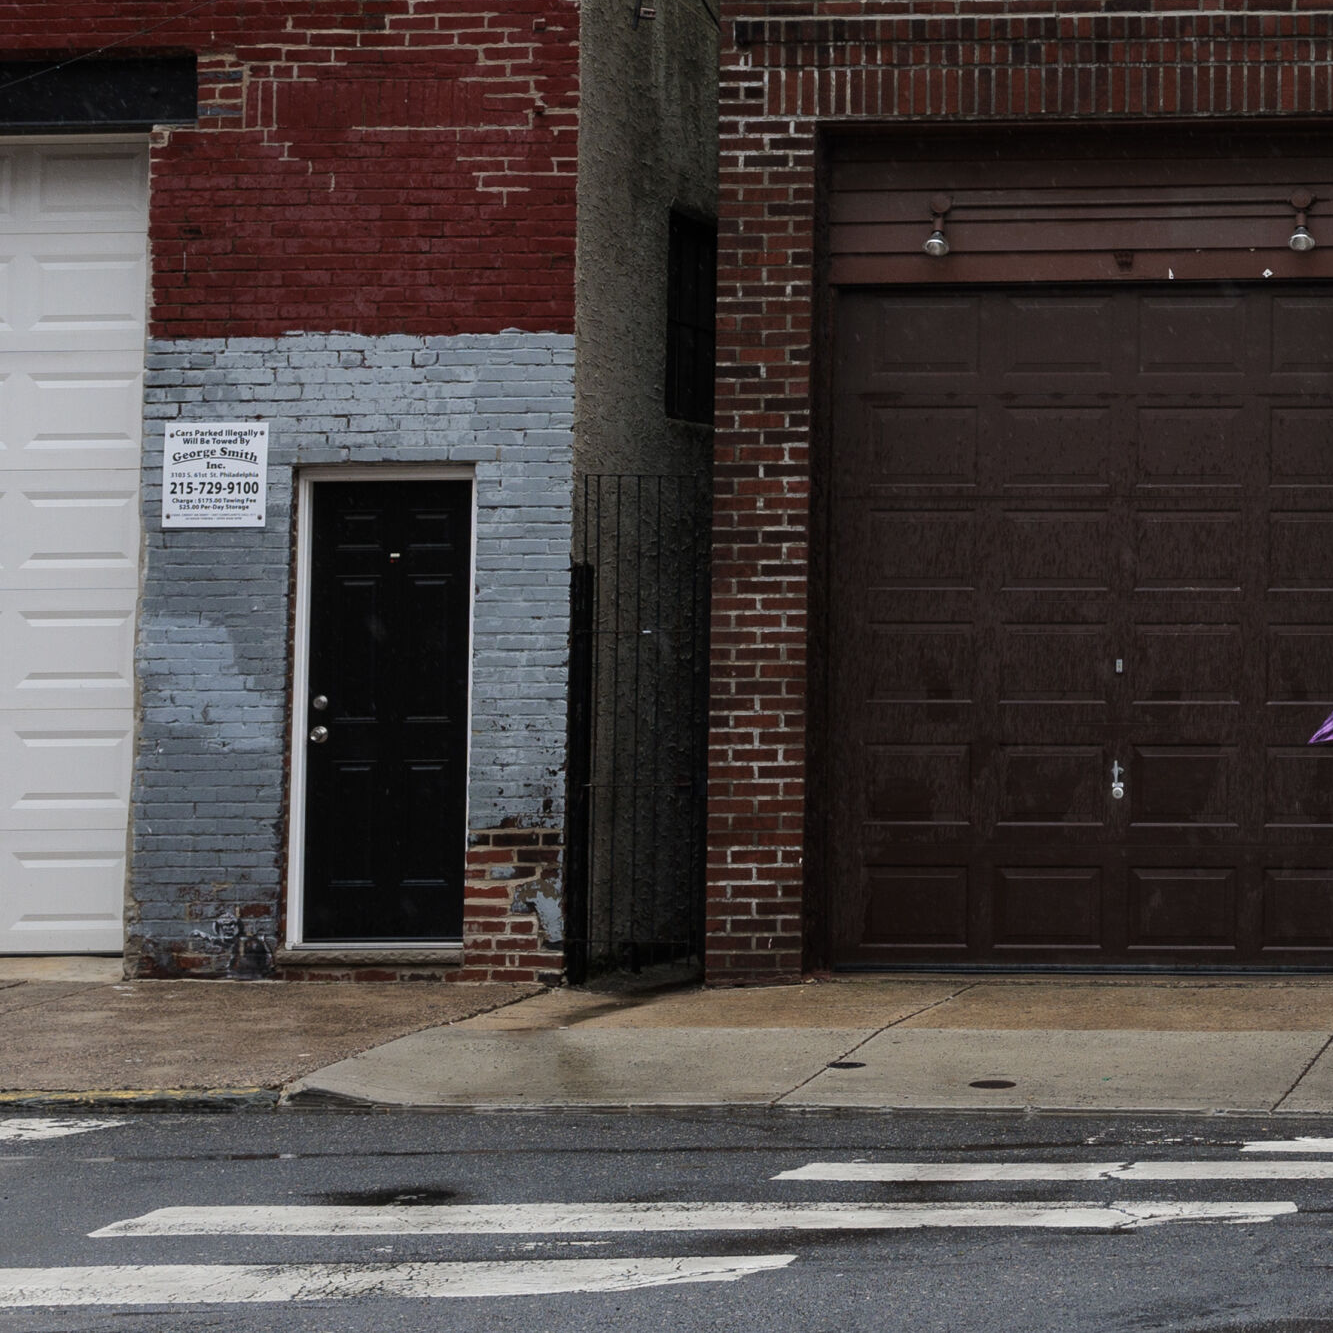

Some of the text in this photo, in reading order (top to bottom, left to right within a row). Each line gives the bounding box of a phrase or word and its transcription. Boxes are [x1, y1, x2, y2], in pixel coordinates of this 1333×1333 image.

[225, 429, 258, 438] Illegally
[239, 438, 250, 446] By
[172, 446, 258, 462] George Smith
[206, 461, 226, 469] Inc.
[219, 471, 259, 479] Philadelphia
[170, 481, 259, 495] 215-729-9100
